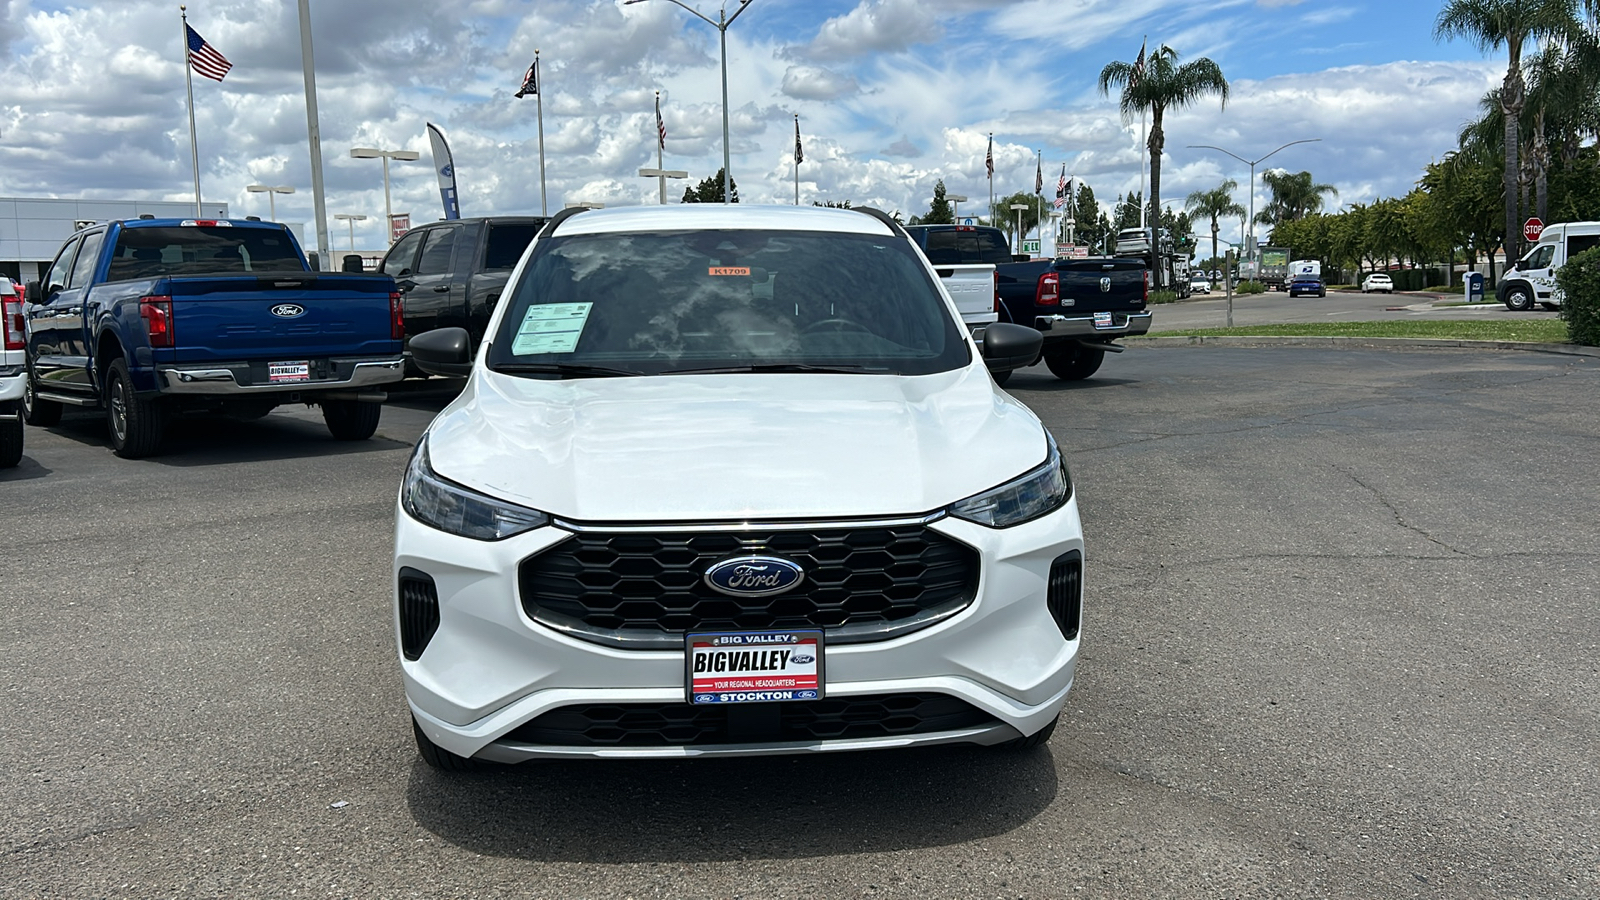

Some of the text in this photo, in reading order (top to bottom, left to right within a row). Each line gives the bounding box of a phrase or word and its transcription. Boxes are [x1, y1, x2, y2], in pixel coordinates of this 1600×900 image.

[1525, 225, 1542, 234] STOP
[277, 306, 298, 315] Ford
[270, 366, 300, 375] BIGVALLEY
[728, 565, 781, 588] Ford
[720, 634, 790, 644] BIG VALLEY
[694, 650, 791, 673] BIGVALLEY
[714, 679, 796, 689] YOUR REGIONAL HEADQUARTERS
[720, 691, 792, 702] STOCKTON
